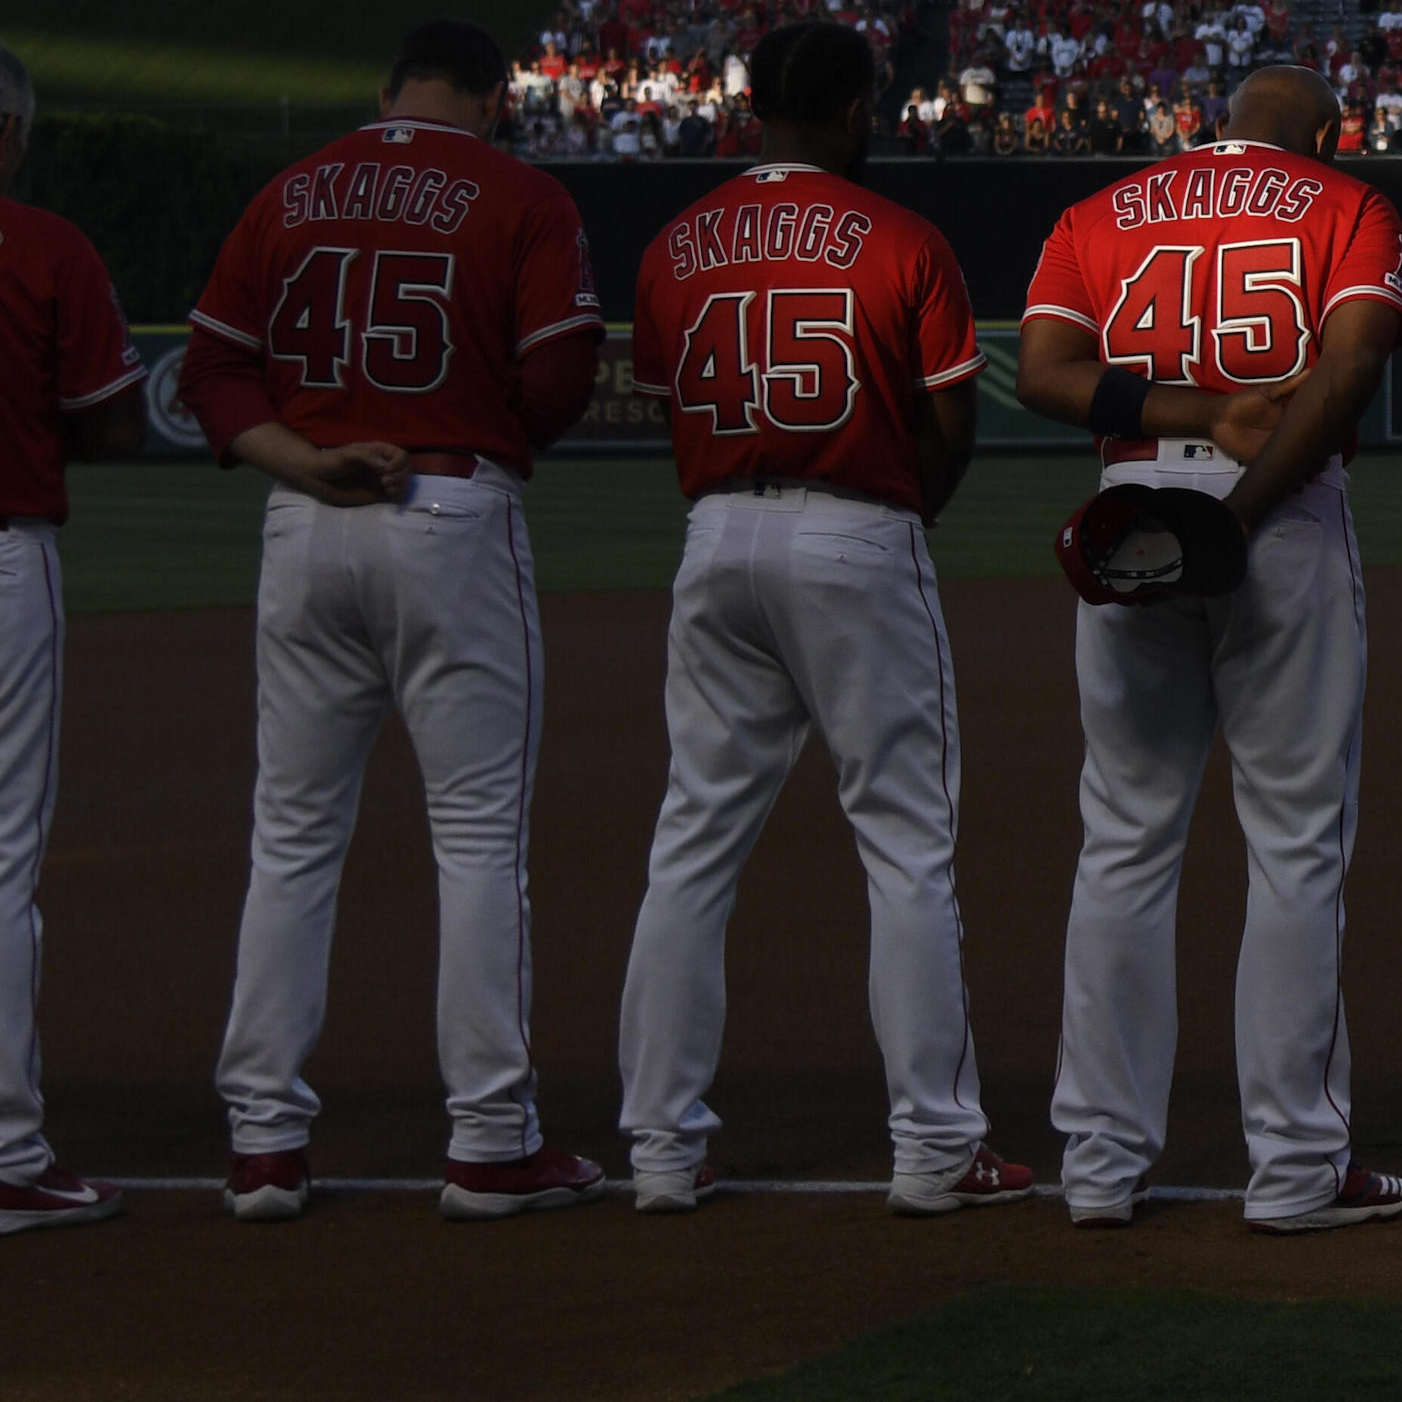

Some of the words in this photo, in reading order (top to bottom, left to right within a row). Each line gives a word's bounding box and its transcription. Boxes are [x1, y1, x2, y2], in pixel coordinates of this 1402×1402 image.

[283, 163, 480, 234] SKAGGS
[669, 202, 873, 281] SKAGGS
[1112, 168, 1324, 231] SKAGGS
[268, 246, 455, 393] 45
[675, 288, 861, 437] 45
[1102, 238, 1313, 386] 45
